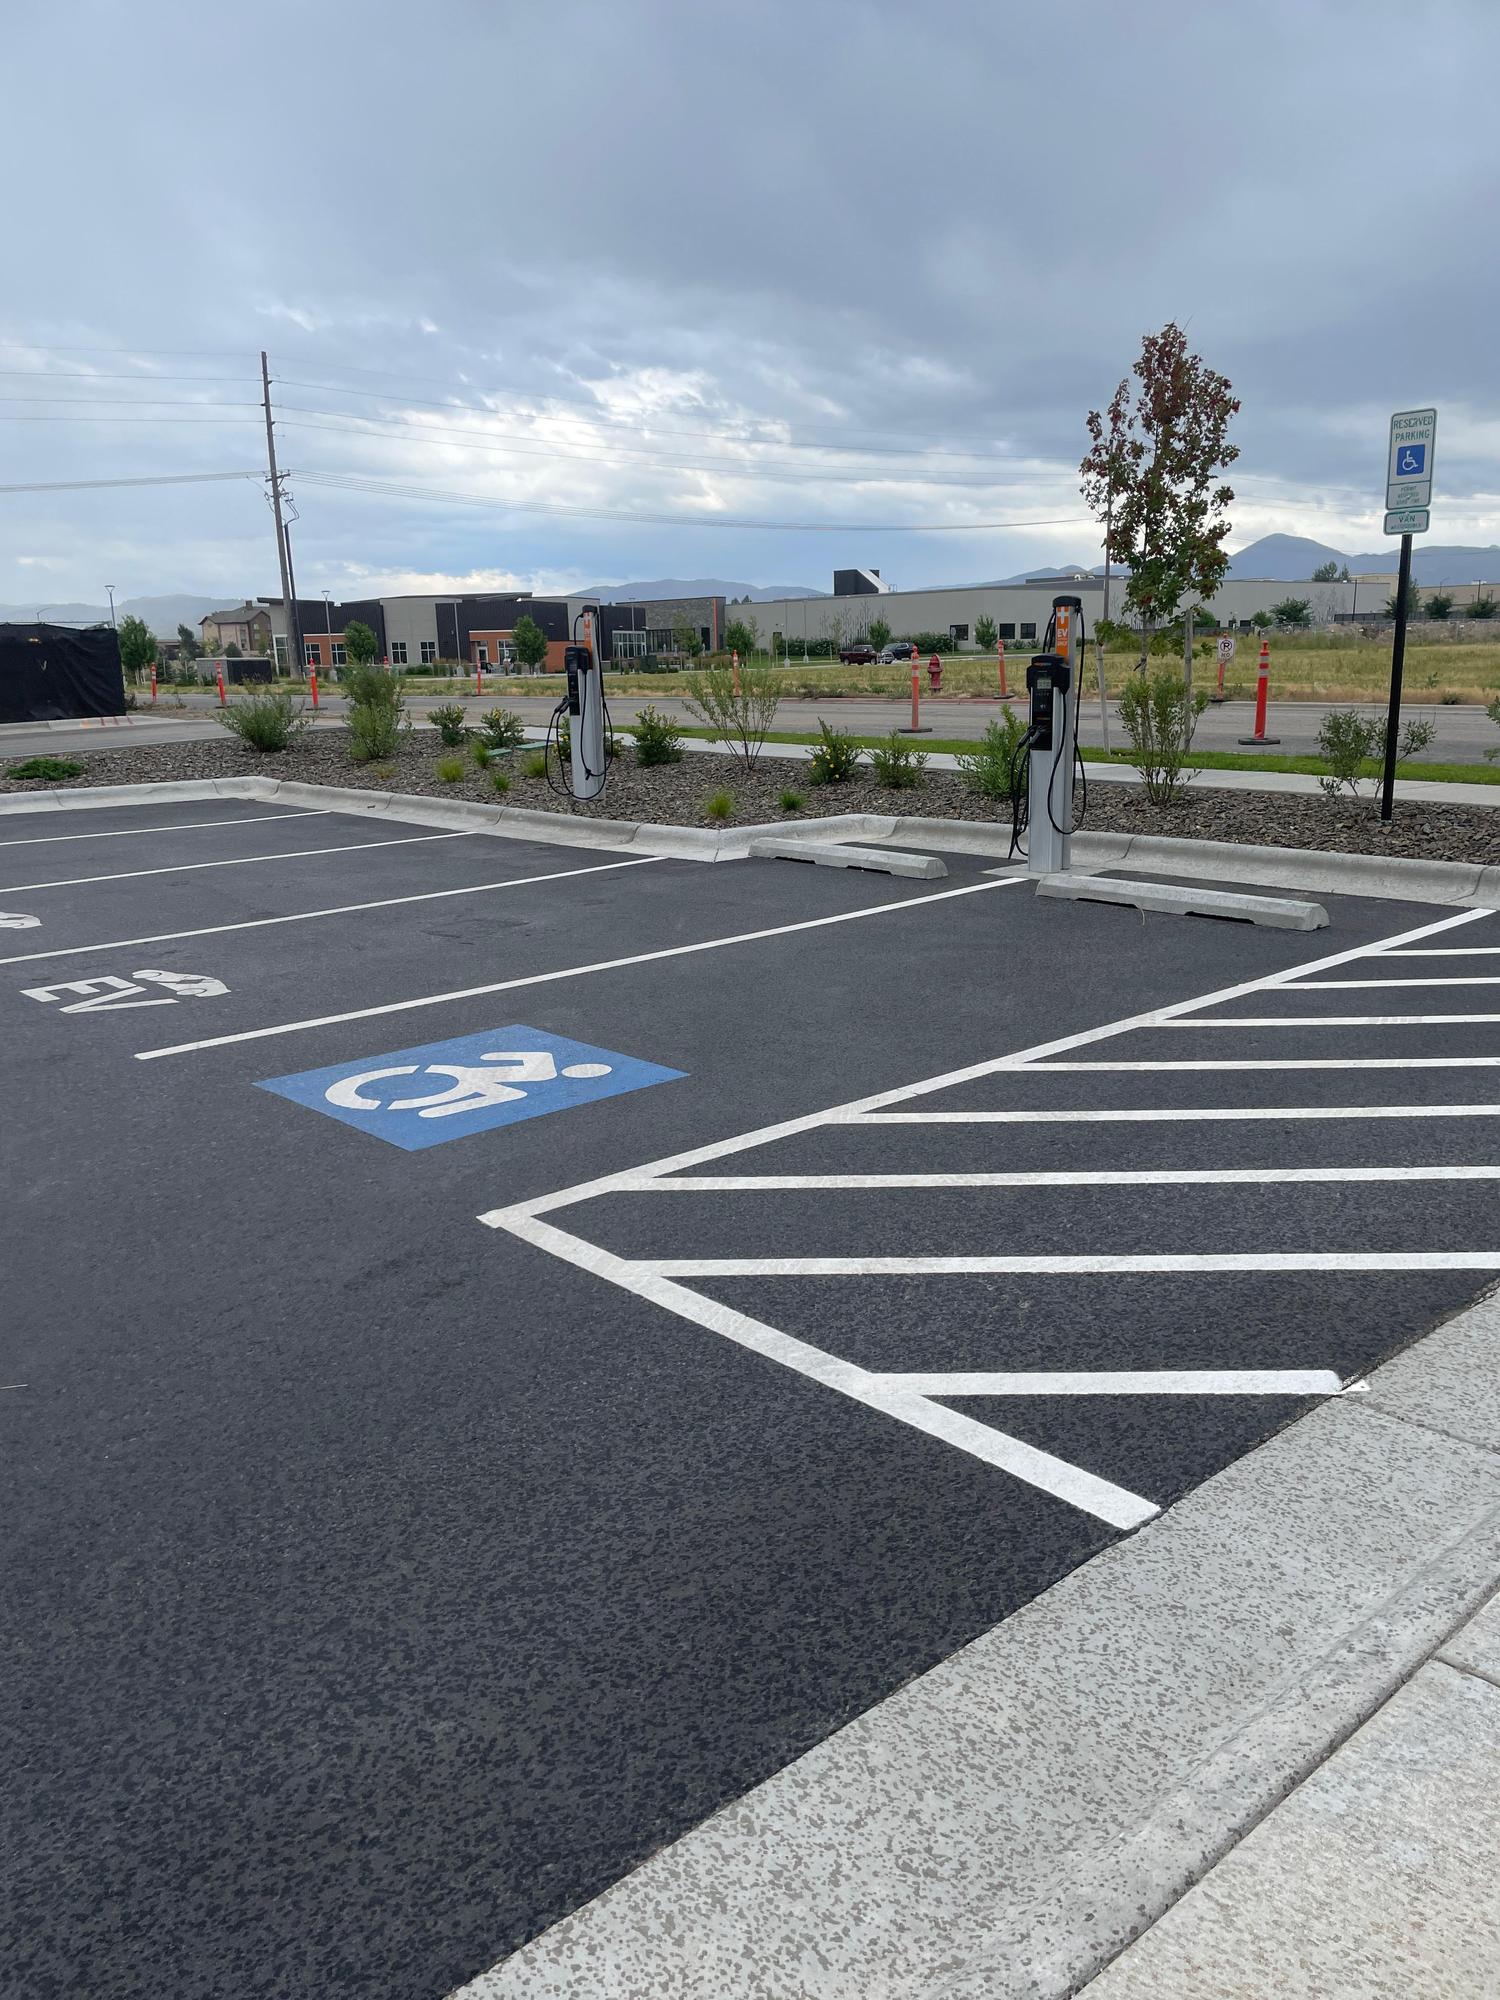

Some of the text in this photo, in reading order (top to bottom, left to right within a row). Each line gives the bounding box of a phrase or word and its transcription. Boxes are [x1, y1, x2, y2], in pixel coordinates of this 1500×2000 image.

[1393, 415, 1433, 430] RESERVED
[1395, 429, 1430, 442] PARKING
[1398, 515, 1416, 523] VAN
[1057, 628, 1068, 638] EV
[19, 975, 180, 1014] EV
